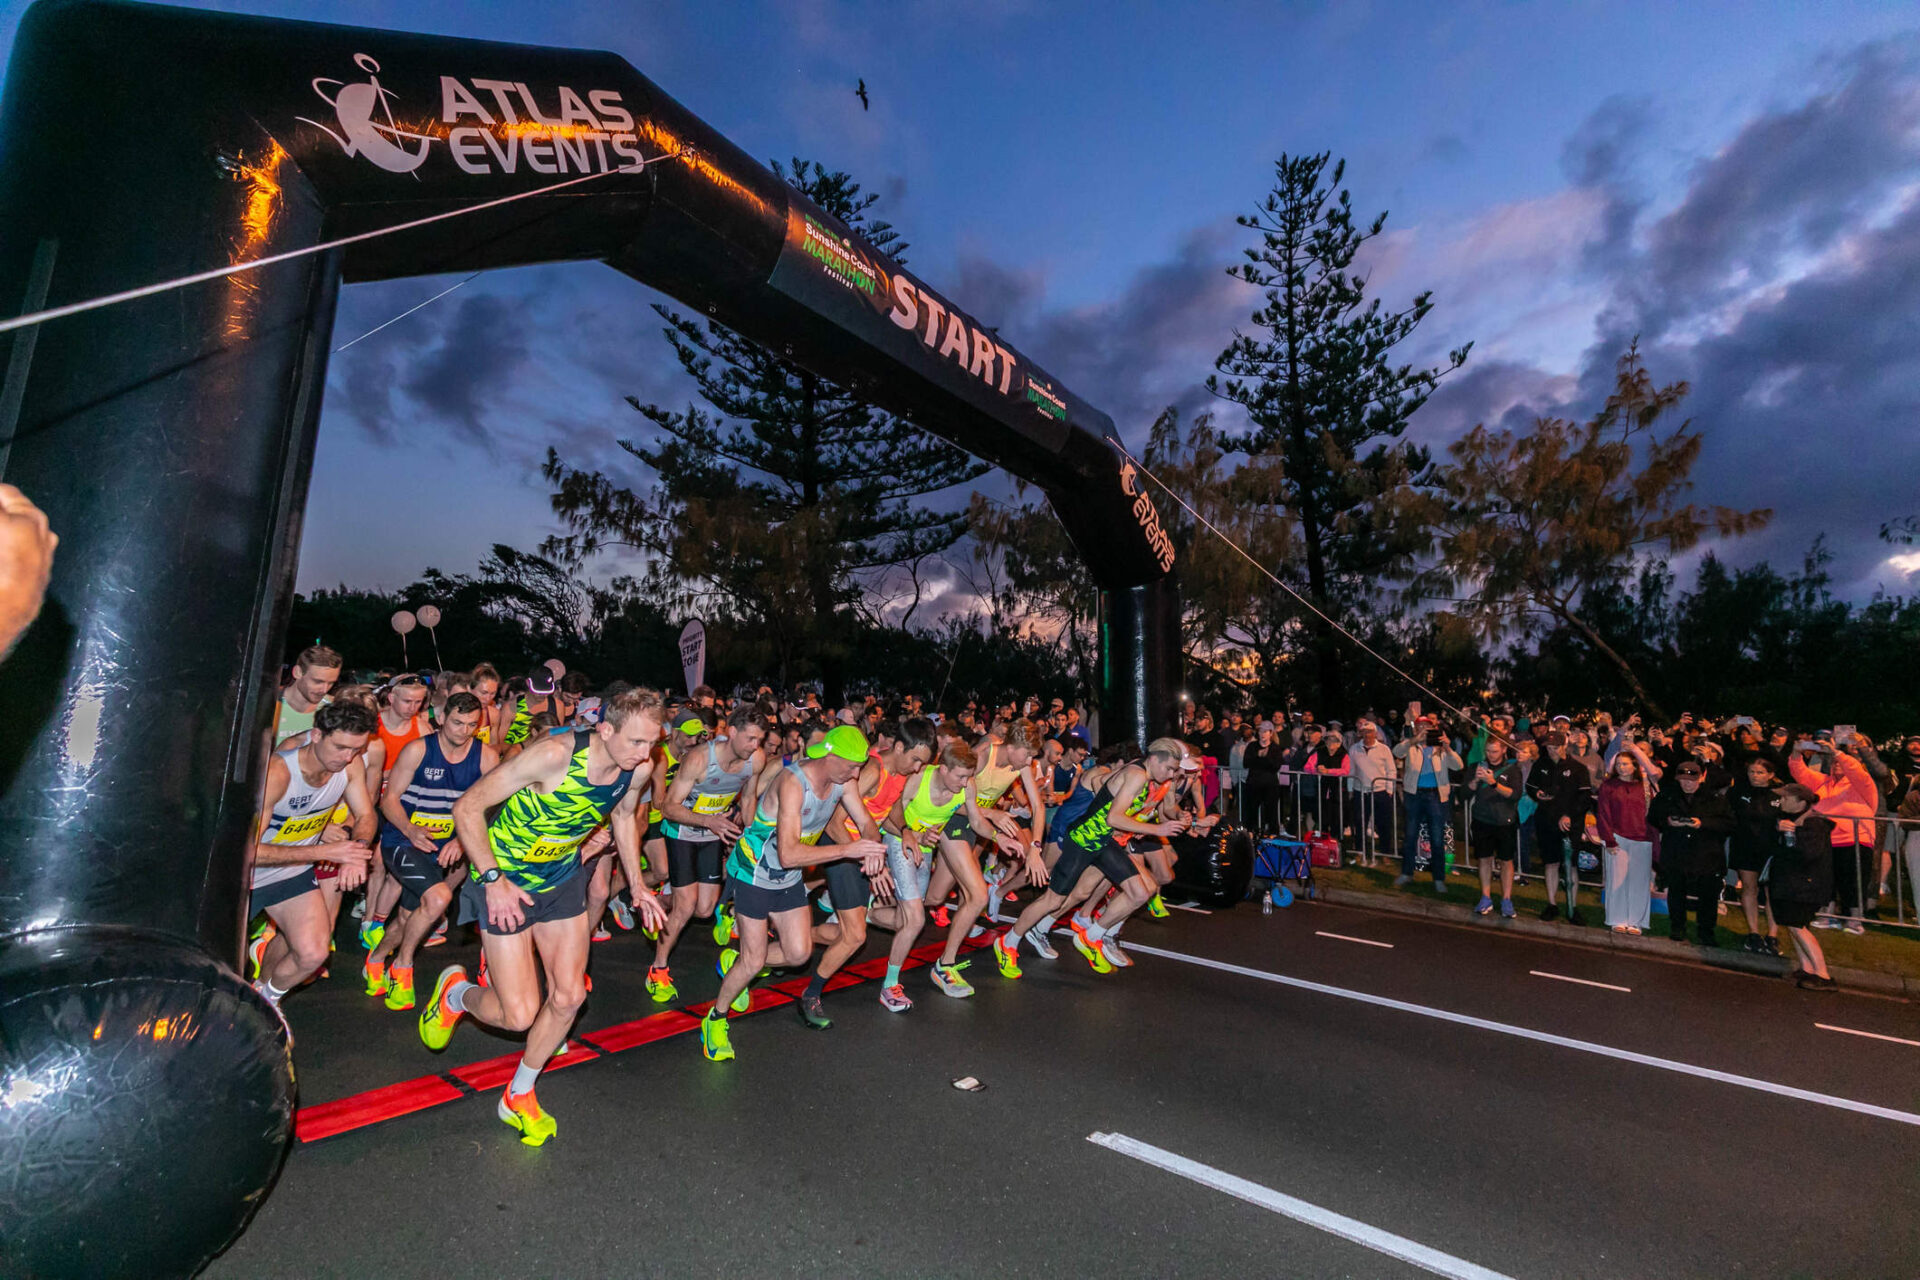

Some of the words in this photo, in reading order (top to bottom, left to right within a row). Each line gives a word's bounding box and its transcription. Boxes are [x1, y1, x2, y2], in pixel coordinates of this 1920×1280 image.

[440, 76, 635, 131] ATLAS
[449, 127, 645, 175] EVENTS
[803, 234, 876, 295] MARATHON
[805, 222, 850, 260] Sunshine
[850, 254, 876, 279] Coast
[823, 265, 853, 289] Festival
[889, 274, 1016, 395] START
[1132, 498, 1172, 573] EVENTS
[682, 640, 702, 657] START
